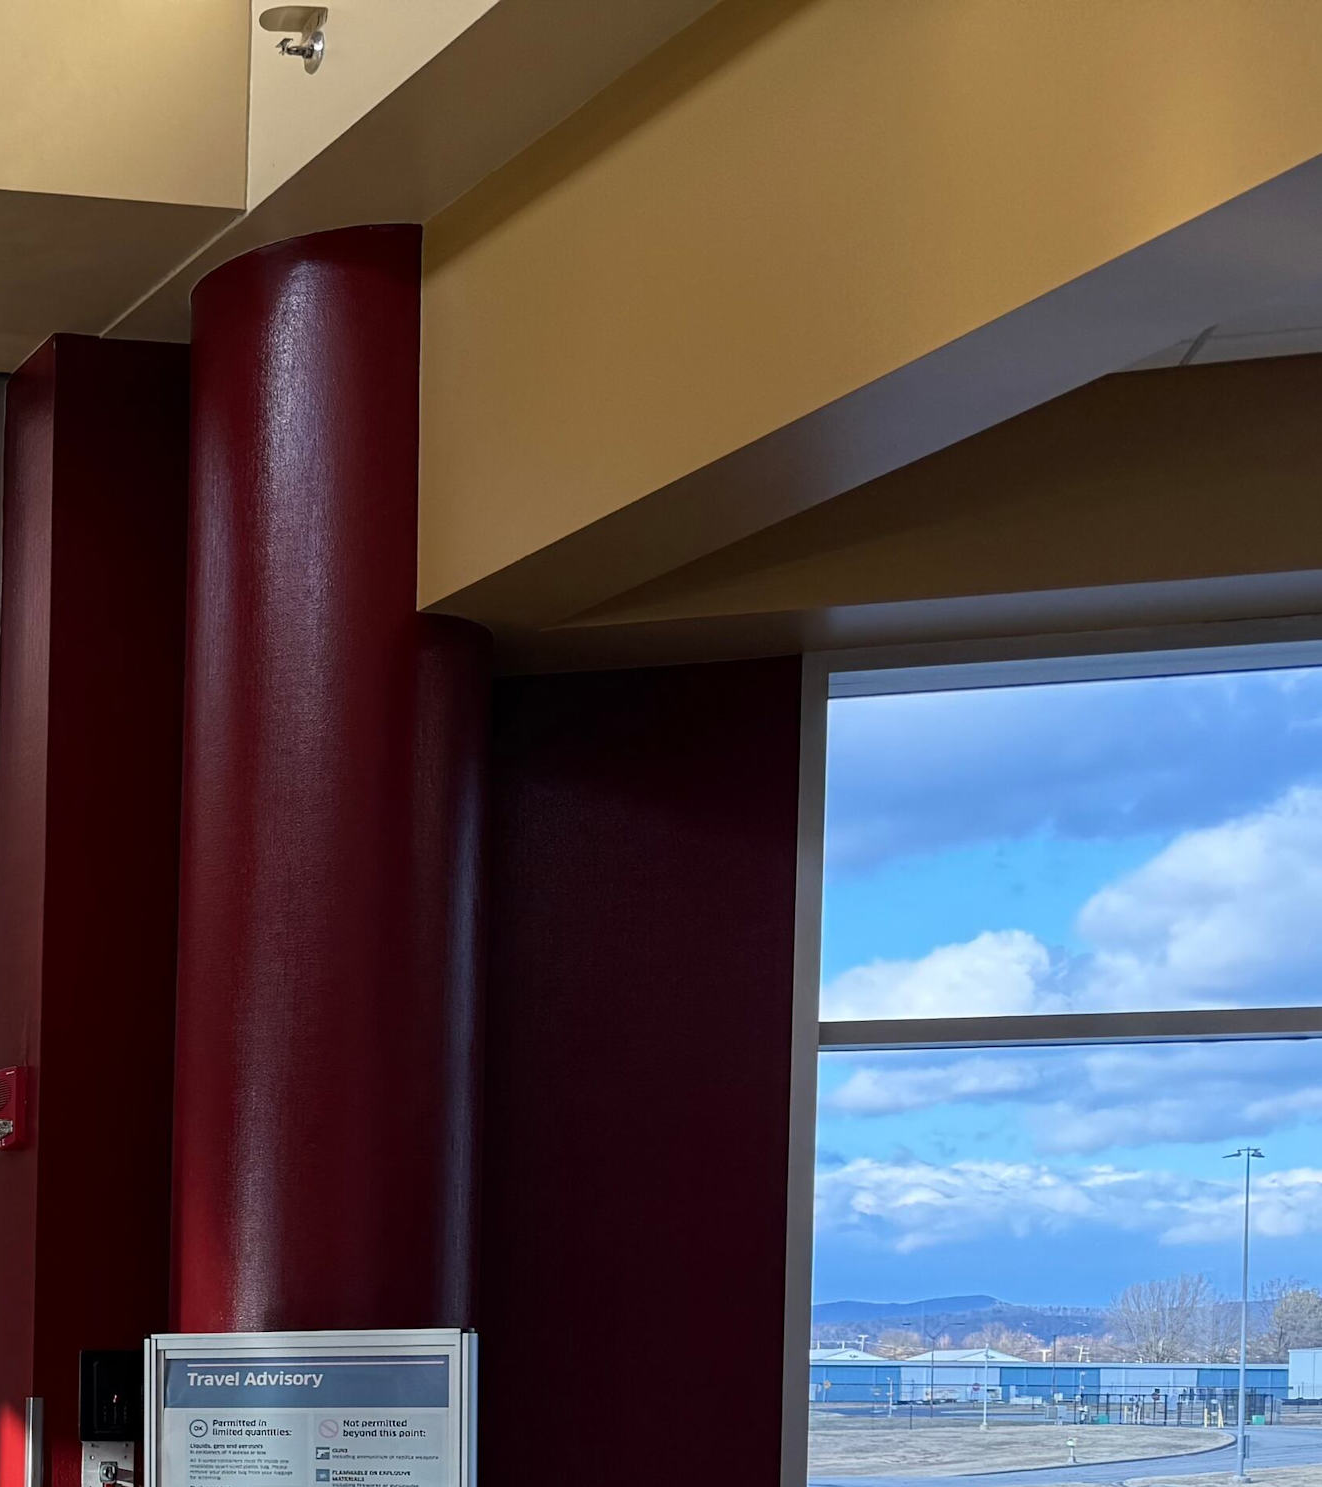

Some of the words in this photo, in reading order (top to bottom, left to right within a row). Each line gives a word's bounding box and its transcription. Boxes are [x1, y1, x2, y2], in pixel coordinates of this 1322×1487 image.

[187, 1371, 239, 1386] Travel
[244, 1372, 323, 1388] Advisory
[212, 1419, 256, 1428] Permitted
[258, 1419, 267, 1427] in
[343, 1419, 359, 1427] Not
[361, 1419, 407, 1428] permitted
[212, 1427, 242, 1436] limited
[244, 1428, 292, 1438] quantities:
[343, 1429, 377, 1438] beyond
[379, 1428, 396, 1437] this
[399, 1429, 426, 1439] point:
